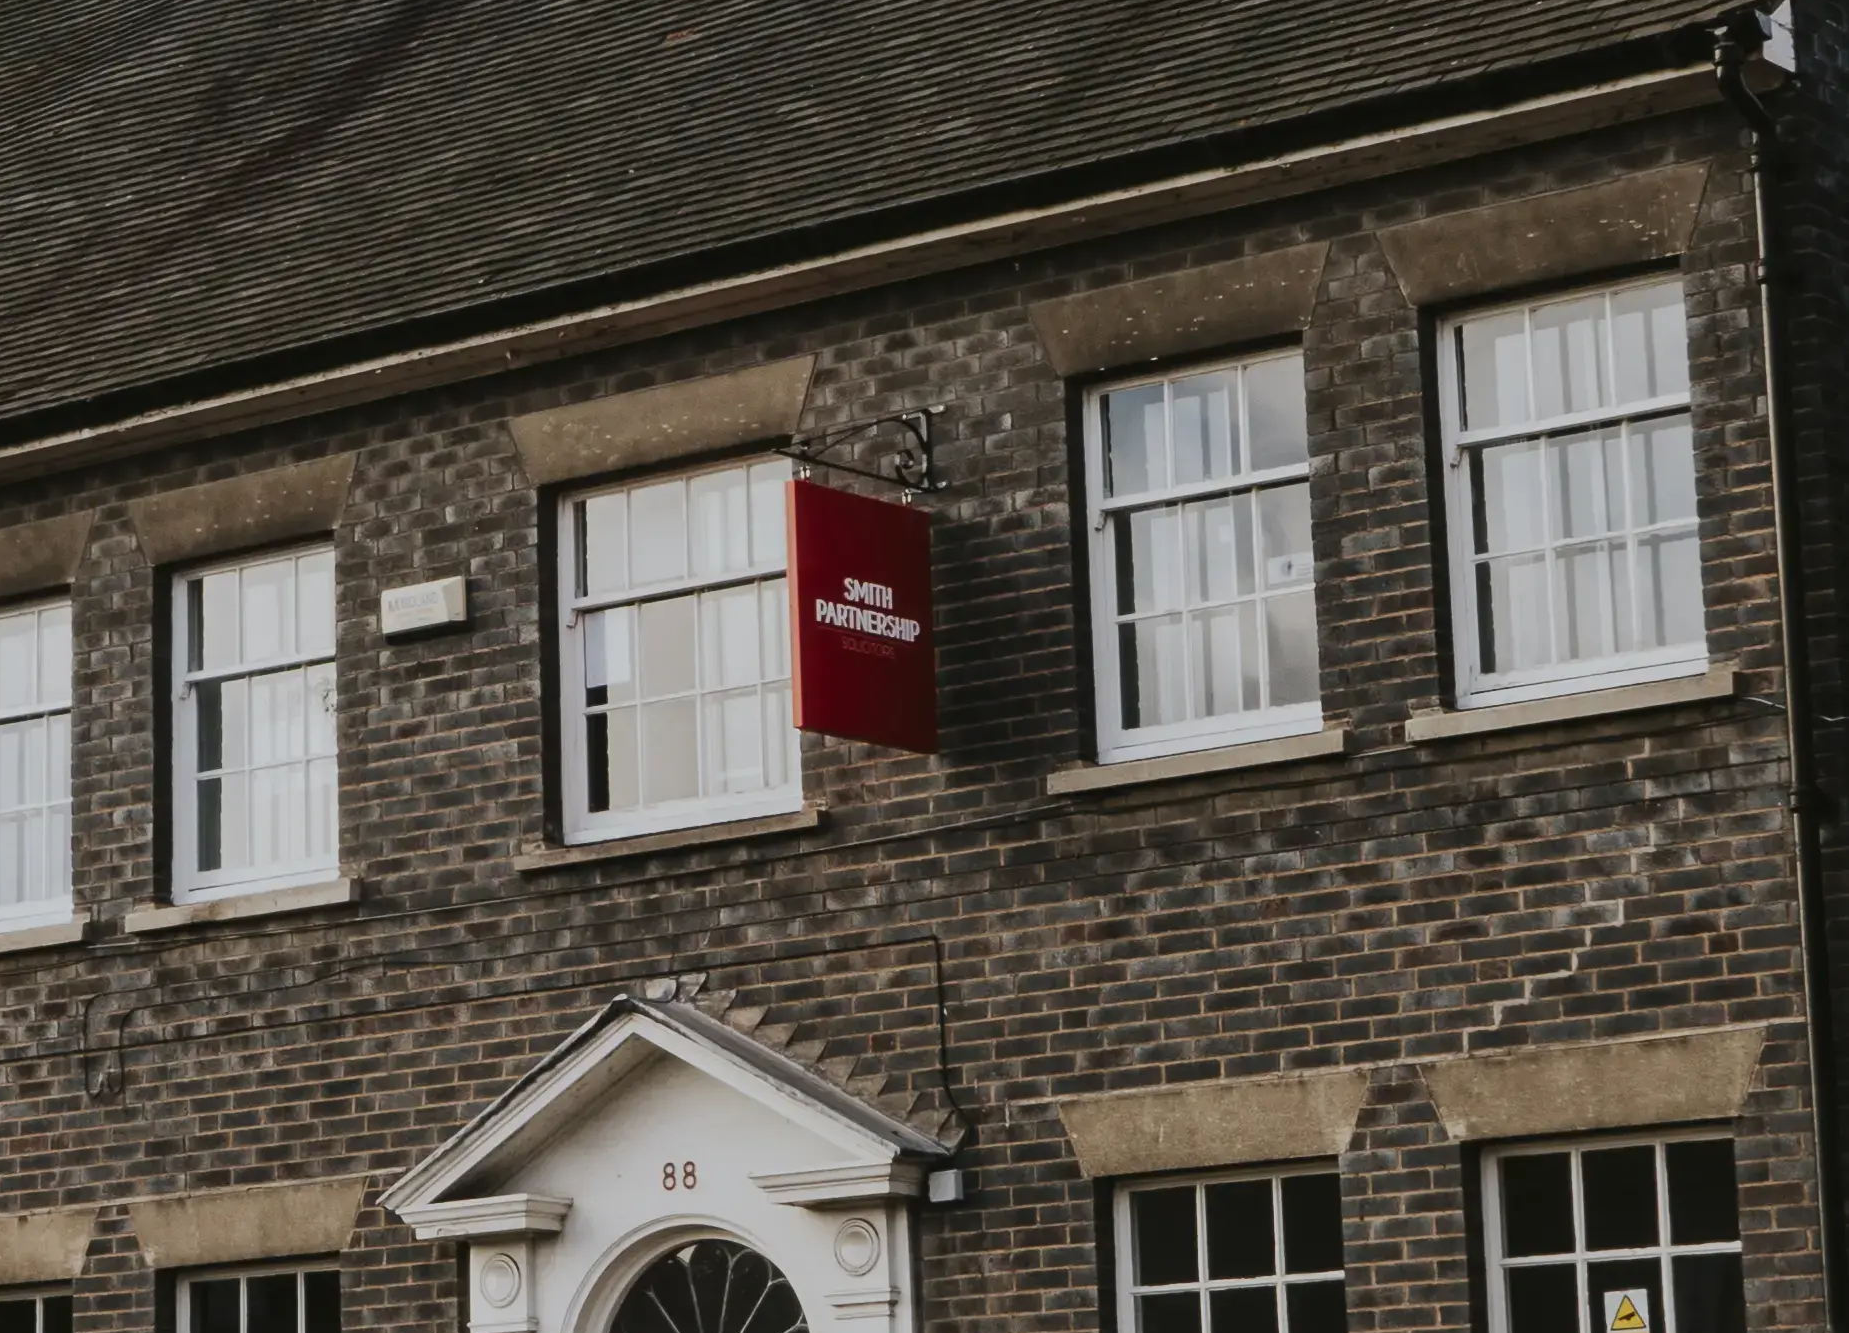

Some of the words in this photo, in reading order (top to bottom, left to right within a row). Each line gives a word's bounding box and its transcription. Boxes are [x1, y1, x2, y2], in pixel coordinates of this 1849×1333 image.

[843, 577, 893, 610] SMITH
[815, 598, 920, 642] PARTNERSHIP
[662, 1160, 697, 1191] 88
